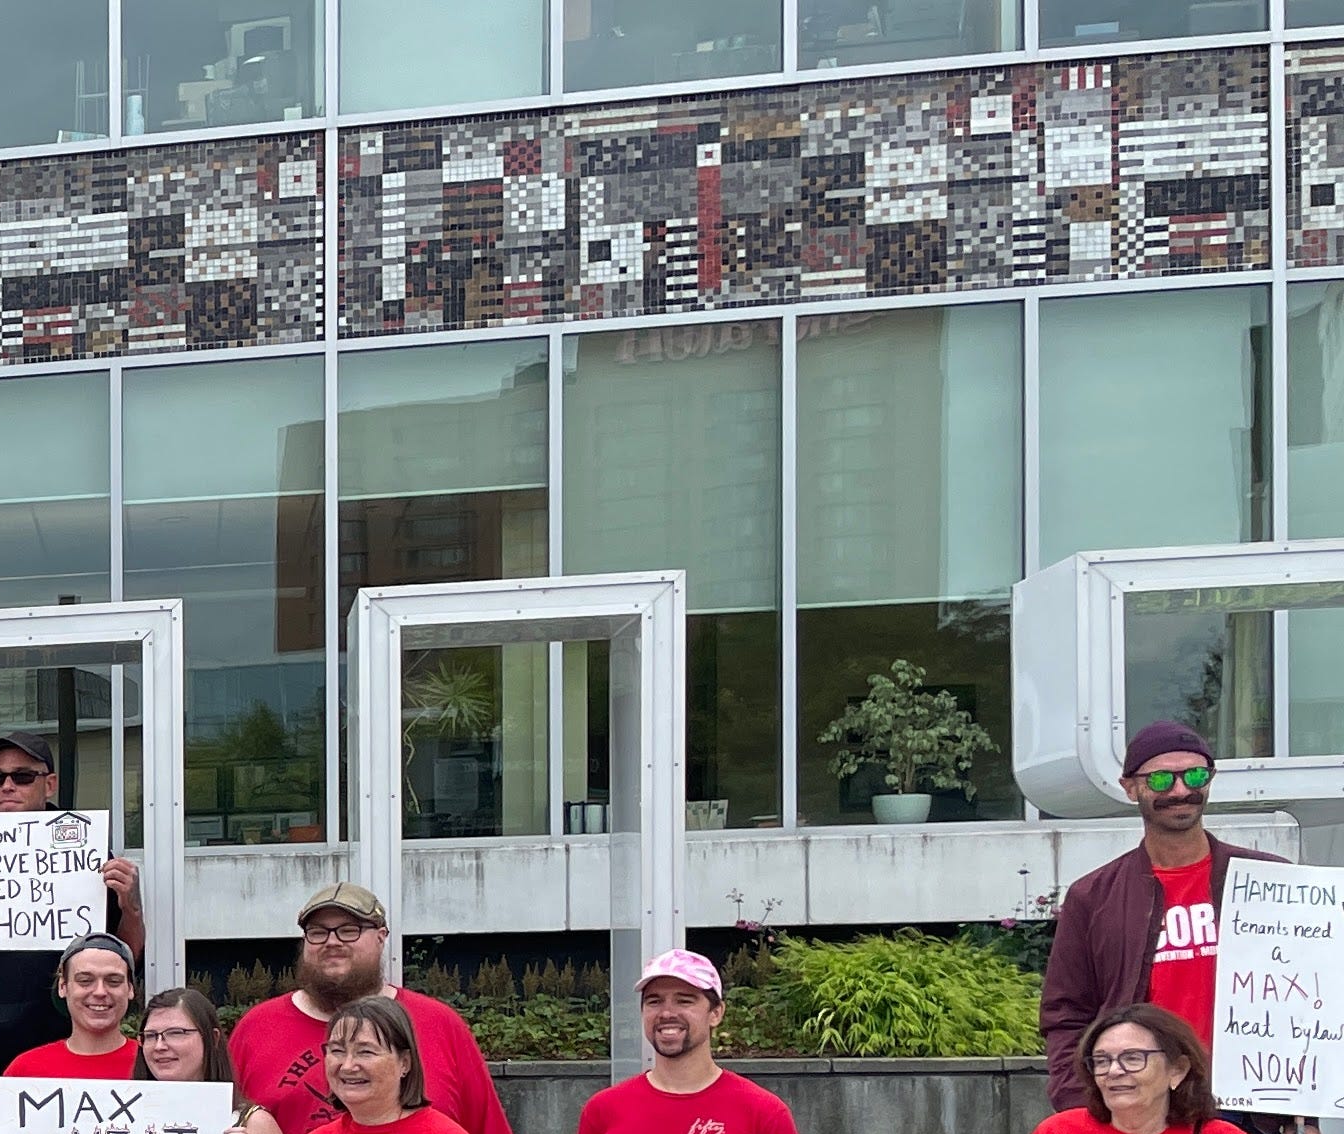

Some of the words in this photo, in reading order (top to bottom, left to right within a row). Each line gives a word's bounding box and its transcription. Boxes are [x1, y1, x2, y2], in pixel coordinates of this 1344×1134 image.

[35, 849, 102, 875] BEING
[1232, 910, 1288, 936] tenants
[1294, 921, 1333, 939] need
[1271, 946, 1291, 964] a
[1224, 1005, 1275, 1038] heat
[1290, 1016, 1344, 1054] bylaw
[277, 1049, 321, 1088] THE
[18, 1088, 143, 1128] MAX
[1216, 1097, 1253, 1106] ACORN
